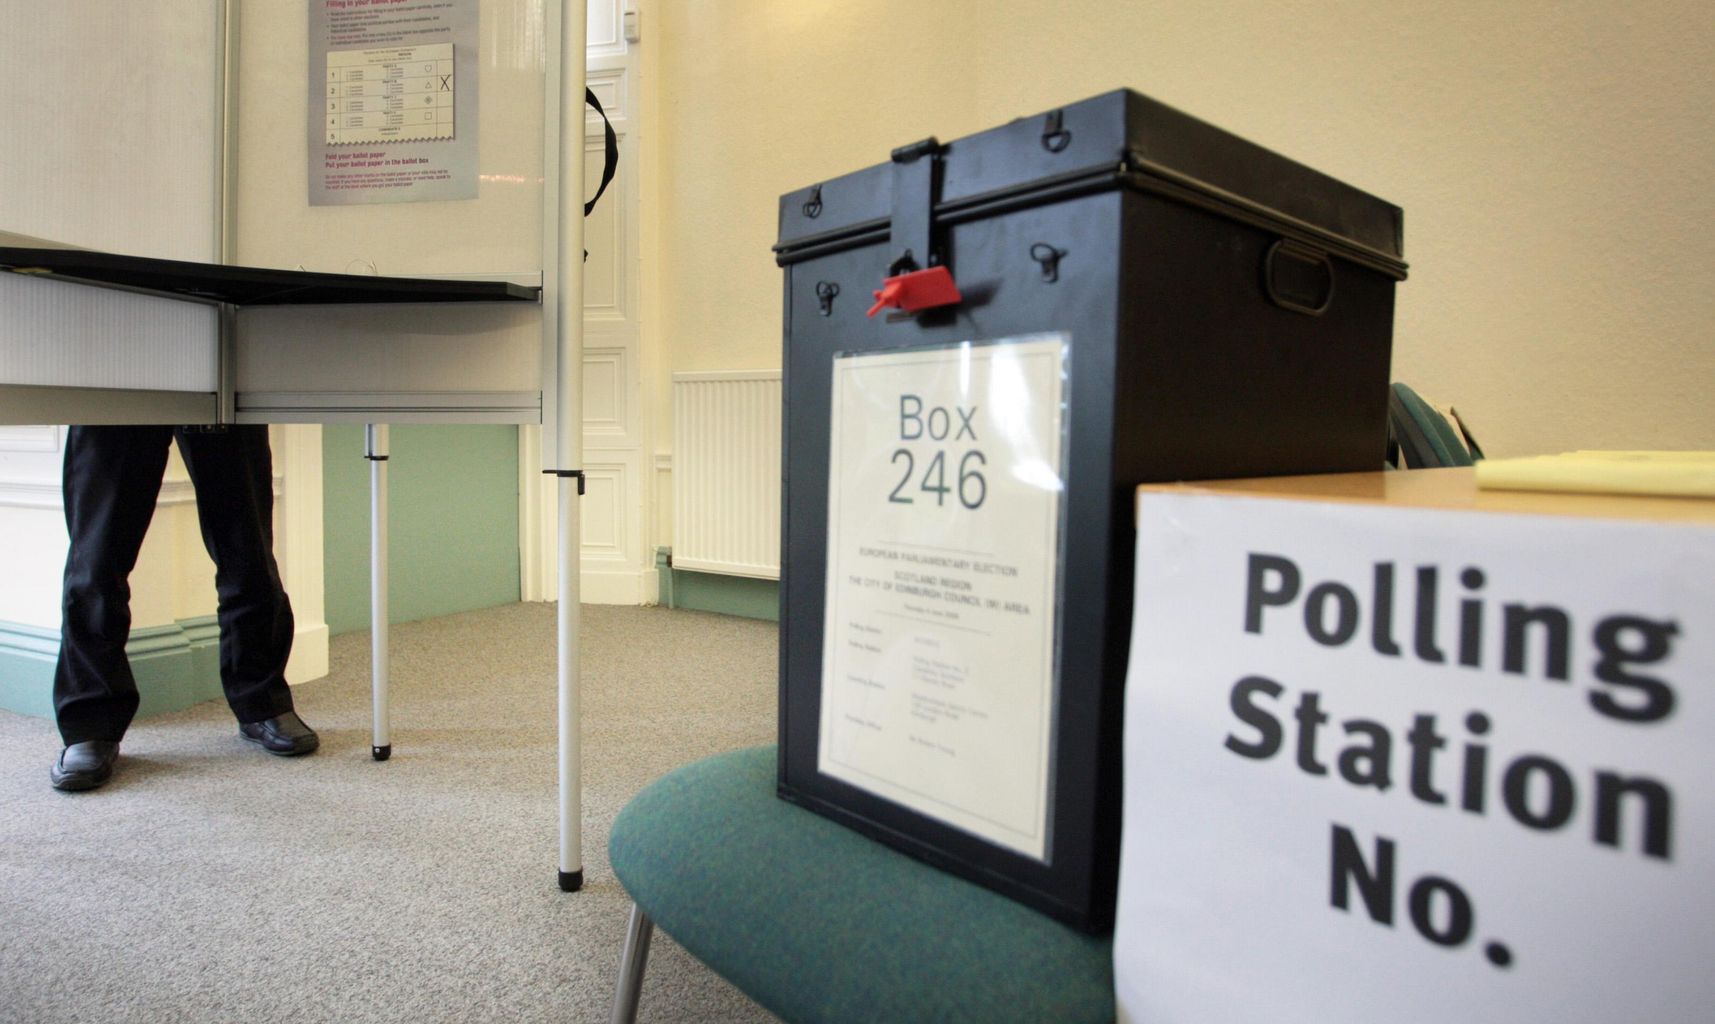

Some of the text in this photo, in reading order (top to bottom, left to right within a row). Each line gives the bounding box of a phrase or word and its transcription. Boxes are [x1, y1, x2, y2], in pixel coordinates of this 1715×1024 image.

[325, 152, 337, 160] Fold
[338, 153, 352, 161] your
[369, 152, 386, 160] paper
[368, 160, 384, 168] paper
[899, 394, 978, 441] Box
[888, 448, 988, 510] 246
[859, 547, 1019, 577] EUROPEAN PARLIAMENTARY ELECTION
[894, 582, 942, 599] EDINBURGH
[944, 590, 981, 608] COUNCIL
[940, 577, 973, 592] REGION
[1243, 551, 1682, 724] Polling
[1223, 675, 1676, 863] Station
[1328, 822, 1515, 971] No.
